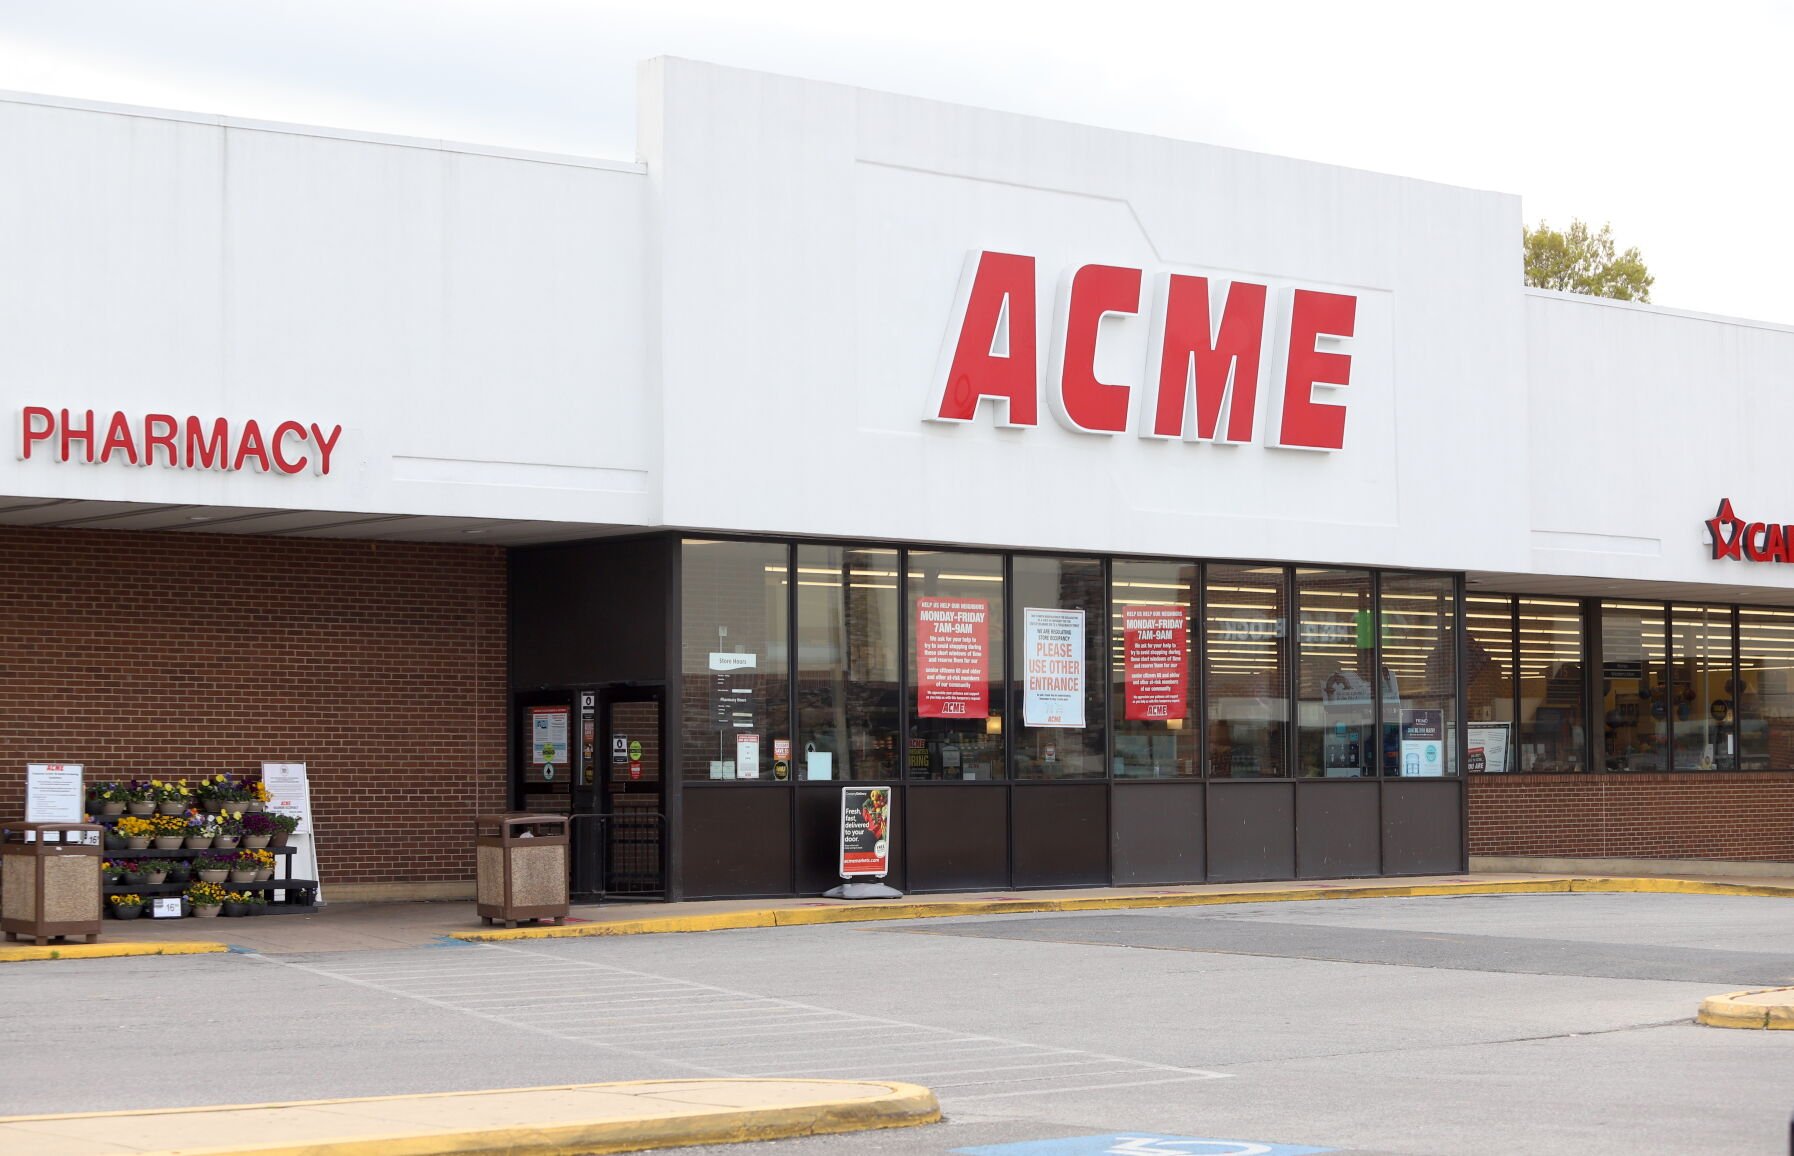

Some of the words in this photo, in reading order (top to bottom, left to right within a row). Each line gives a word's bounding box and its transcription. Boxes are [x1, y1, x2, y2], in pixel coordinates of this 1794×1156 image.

[923, 249, 1356, 452] ACME
[18, 406, 342, 478] PHARMACY
[920, 610, 984, 623] MONDAY-FRIDAY
[934, 623, 972, 634] 7AM-9AM
[1127, 619, 1183, 629] MONDAY-FRIDAY
[1138, 630, 1173, 640] 7AM-9AM
[1037, 642, 1072, 657] PLEASE
[1029, 659, 1047, 674] USE
[1050, 660, 1080, 675] OTHER
[1029, 676, 1079, 691] ENTRANCE
[942, 702, 966, 713] ACME
[1147, 705, 1168, 716] ACME
